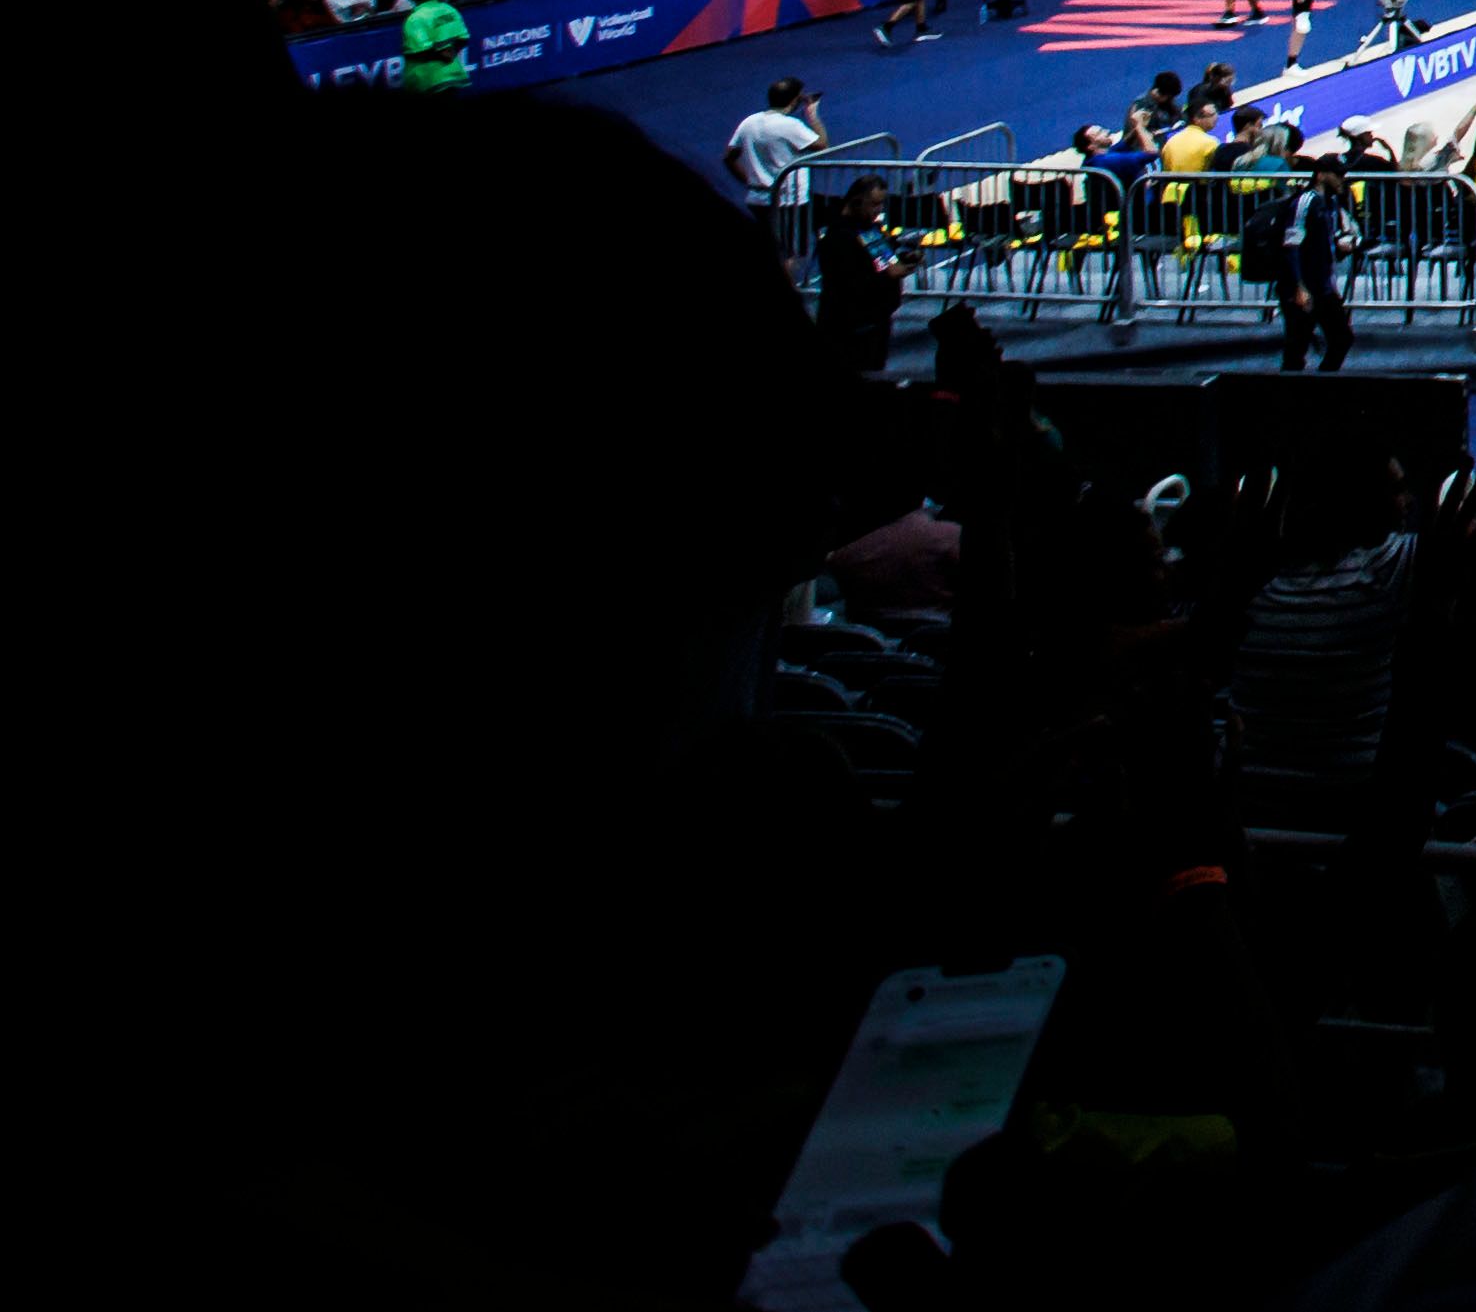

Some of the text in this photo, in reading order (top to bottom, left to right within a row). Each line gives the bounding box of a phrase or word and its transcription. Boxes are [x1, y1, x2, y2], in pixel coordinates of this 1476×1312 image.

[482, 24, 551, 52] NATIONS
[482, 43, 543, 69] LEAGUE
[1418, 36, 1476, 83] VBTV
